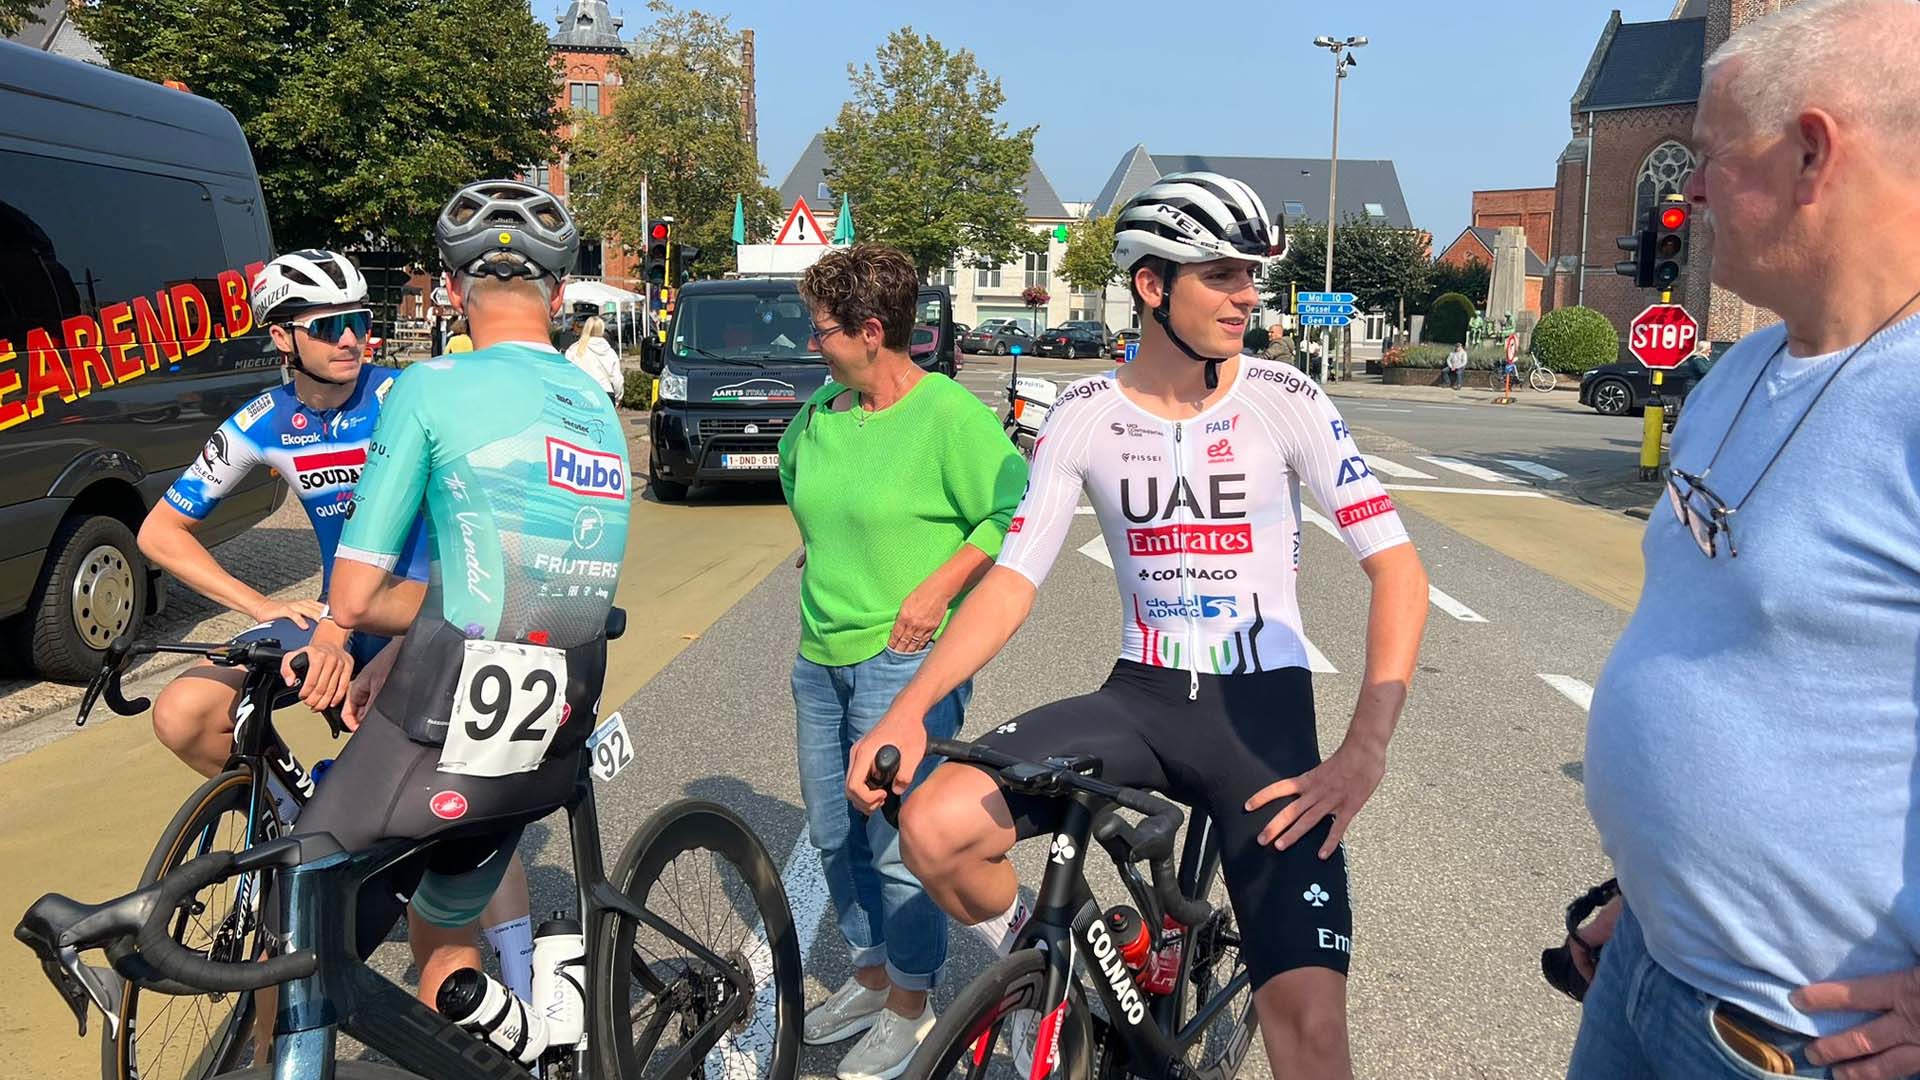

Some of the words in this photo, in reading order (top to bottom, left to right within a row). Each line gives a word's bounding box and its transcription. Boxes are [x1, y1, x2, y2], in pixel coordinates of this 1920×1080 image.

[1633, 323, 1695, 349] STOP
[712, 389, 743, 397] AARTS
[1246, 365, 1319, 400] presight
[281, 432, 321, 446] Ekopak
[193, 463, 222, 485] OLEON
[555, 448, 621, 490] Hubo
[1121, 473, 1246, 523] UAE
[1129, 527, 1249, 554] Emirates
[534, 554, 618, 578] FRIJTERS
[1152, 568, 1238, 581] COLNAGO
[464, 664, 557, 742] 92
[597, 731, 631, 778] 92
[1086, 919, 1144, 1025] COLNAGO
